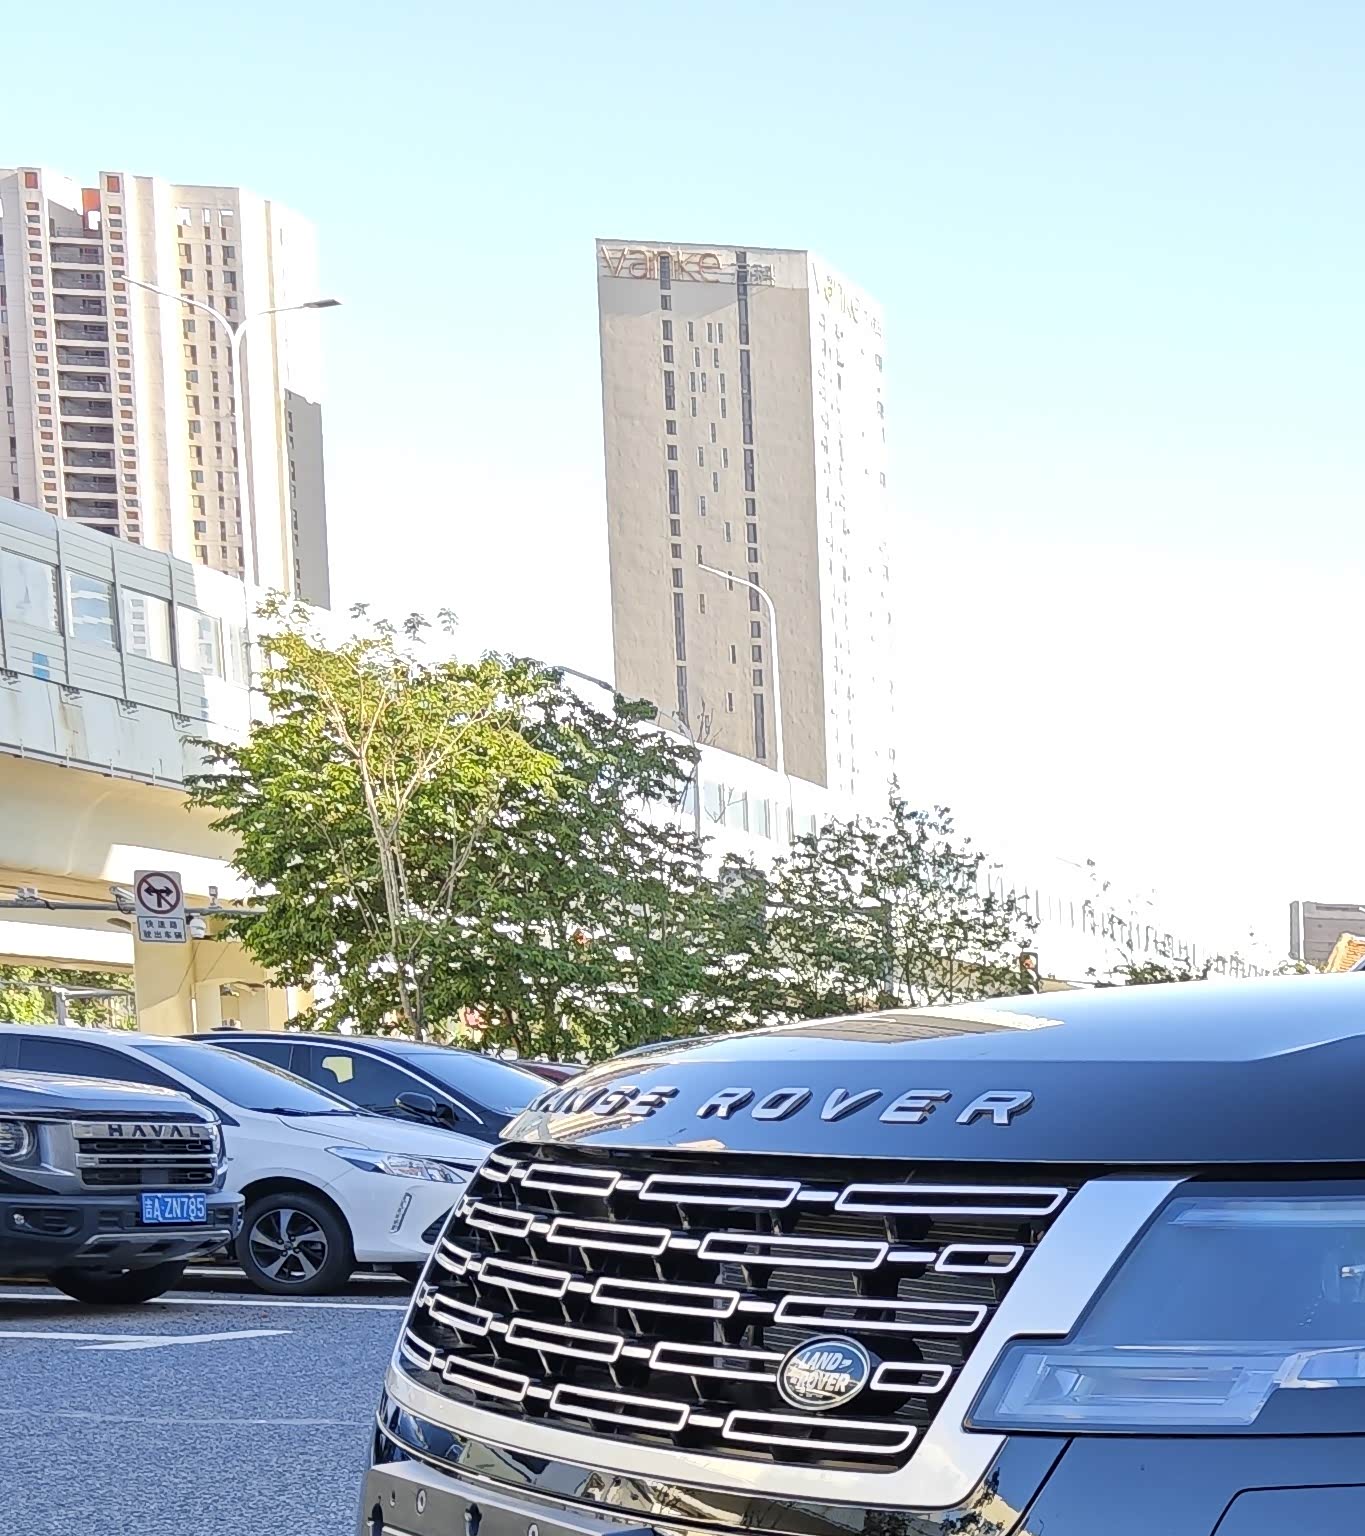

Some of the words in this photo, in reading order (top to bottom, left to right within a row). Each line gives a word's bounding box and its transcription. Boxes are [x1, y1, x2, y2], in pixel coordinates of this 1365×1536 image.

[601, 245, 722, 283] vanke
[696, 1087, 1036, 1127] ROVER
[107, 1124, 200, 1138] HAVAL
[801, 1352, 843, 1370] LAND
[795, 1370, 850, 1392] ROVER
